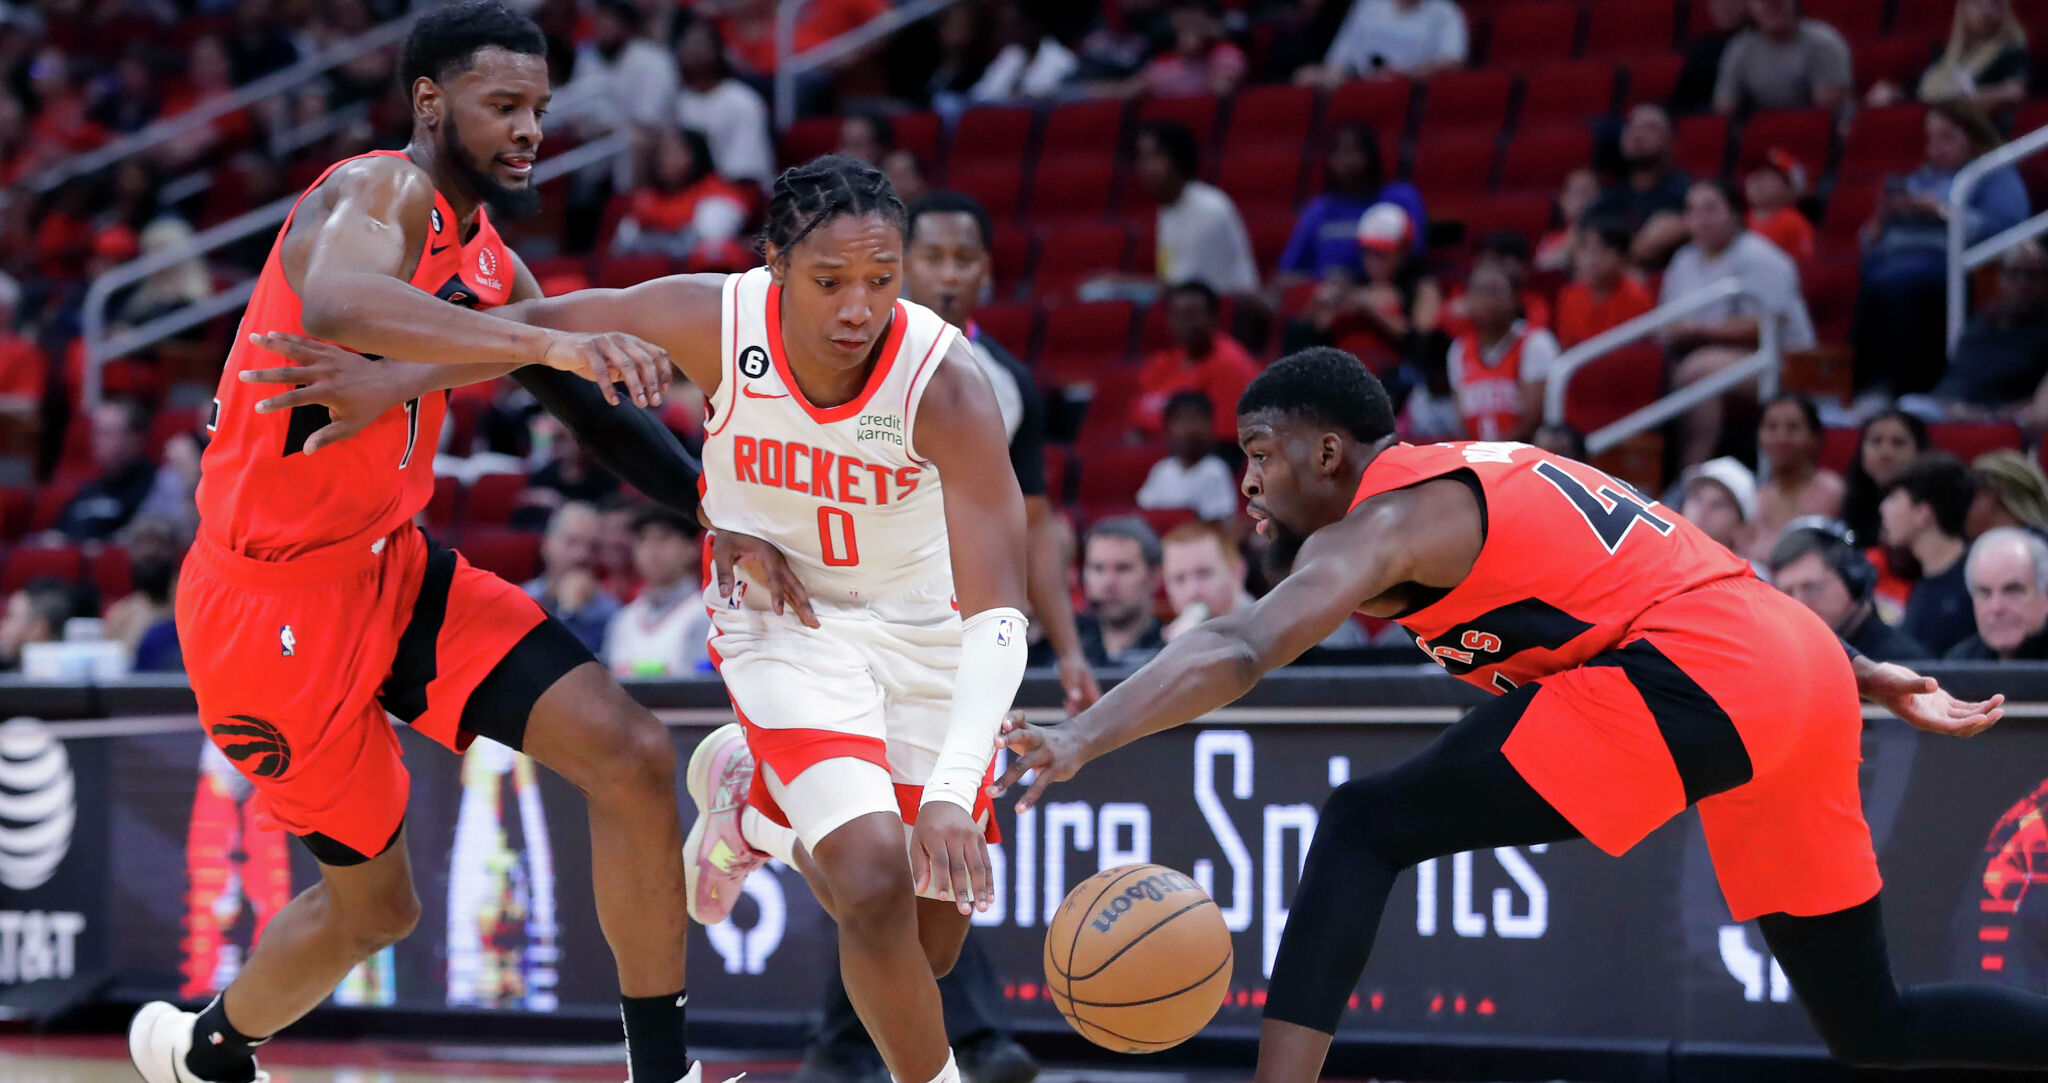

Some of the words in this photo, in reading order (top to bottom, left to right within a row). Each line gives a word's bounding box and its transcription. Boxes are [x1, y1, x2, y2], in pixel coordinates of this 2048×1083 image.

[744, 348, 765, 376] 6
[857, 428, 903, 446] karma
[859, 414, 902, 431] credit
[734, 435, 921, 505] ROCKETS
[817, 505, 860, 567] 0
[1532, 454, 1676, 556] 4
[1091, 872, 1200, 934] Wilson
[0, 910, 87, 984] T&T
